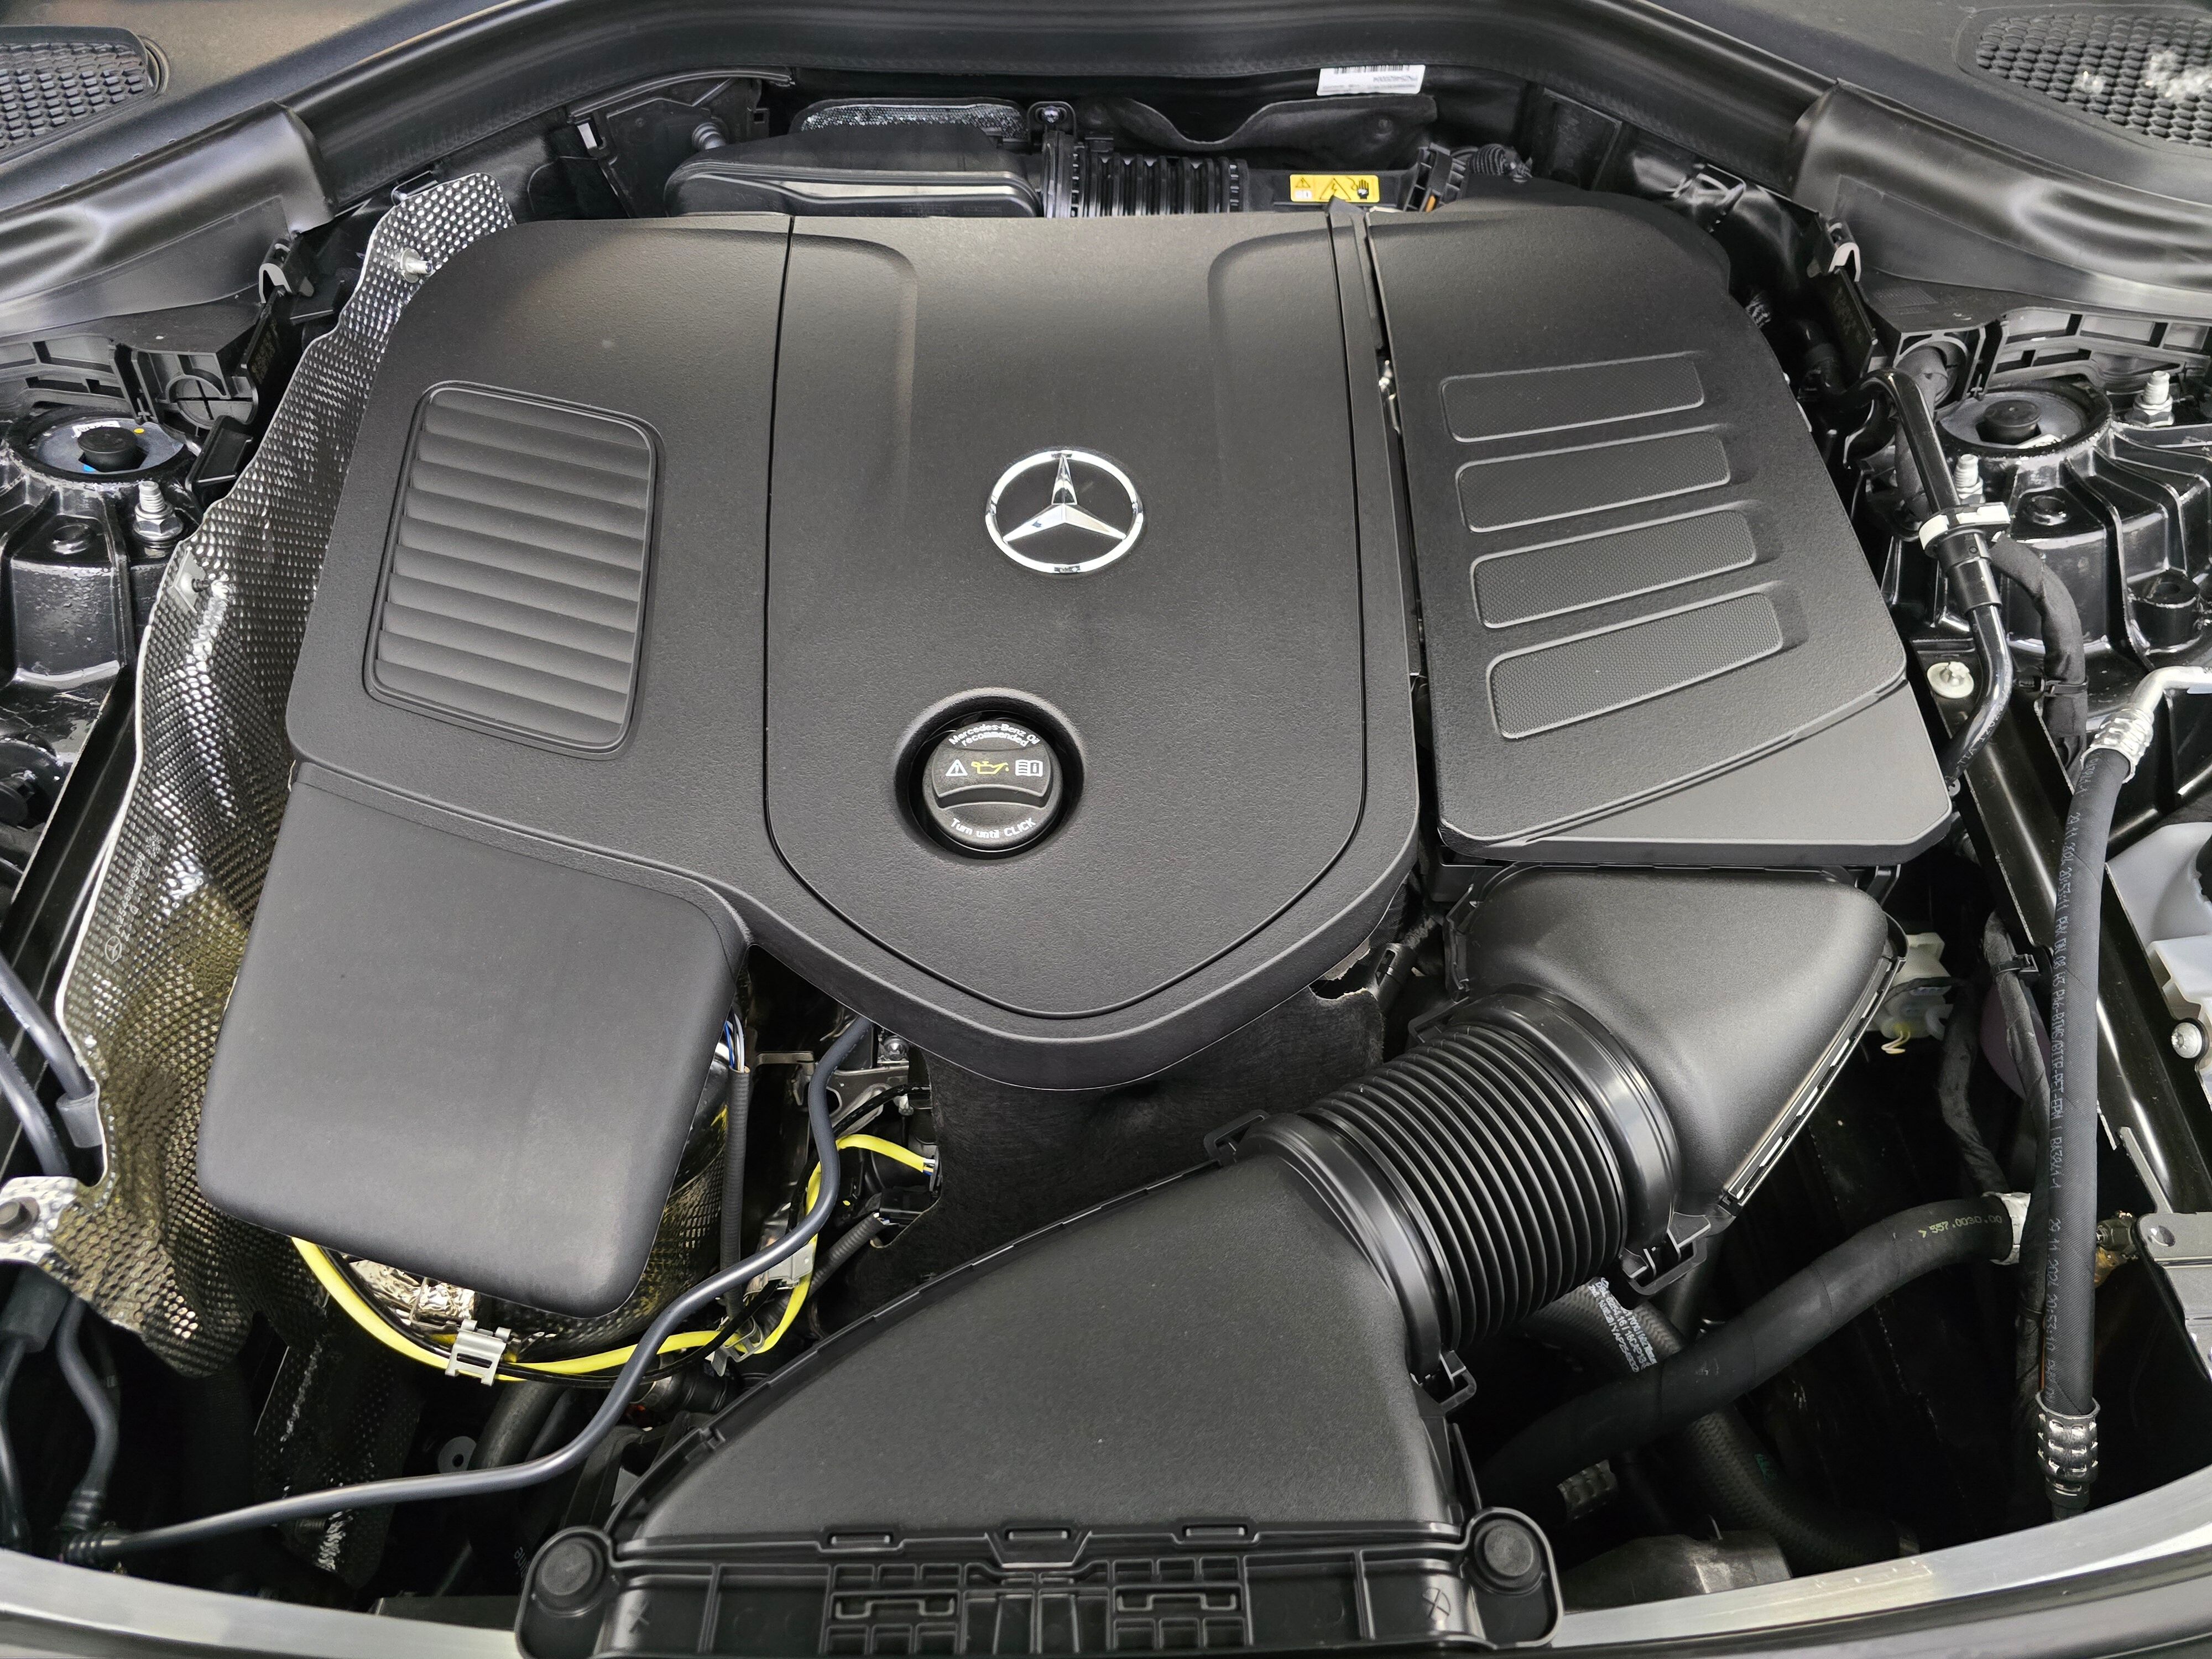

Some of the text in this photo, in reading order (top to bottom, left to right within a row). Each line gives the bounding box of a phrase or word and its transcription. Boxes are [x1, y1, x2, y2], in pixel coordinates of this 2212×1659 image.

[948, 723, 1041, 745] Mercedes-Benz Oil
[961, 731, 1029, 747] recommended
[951, 817, 1036, 839] Turn until CLICK
